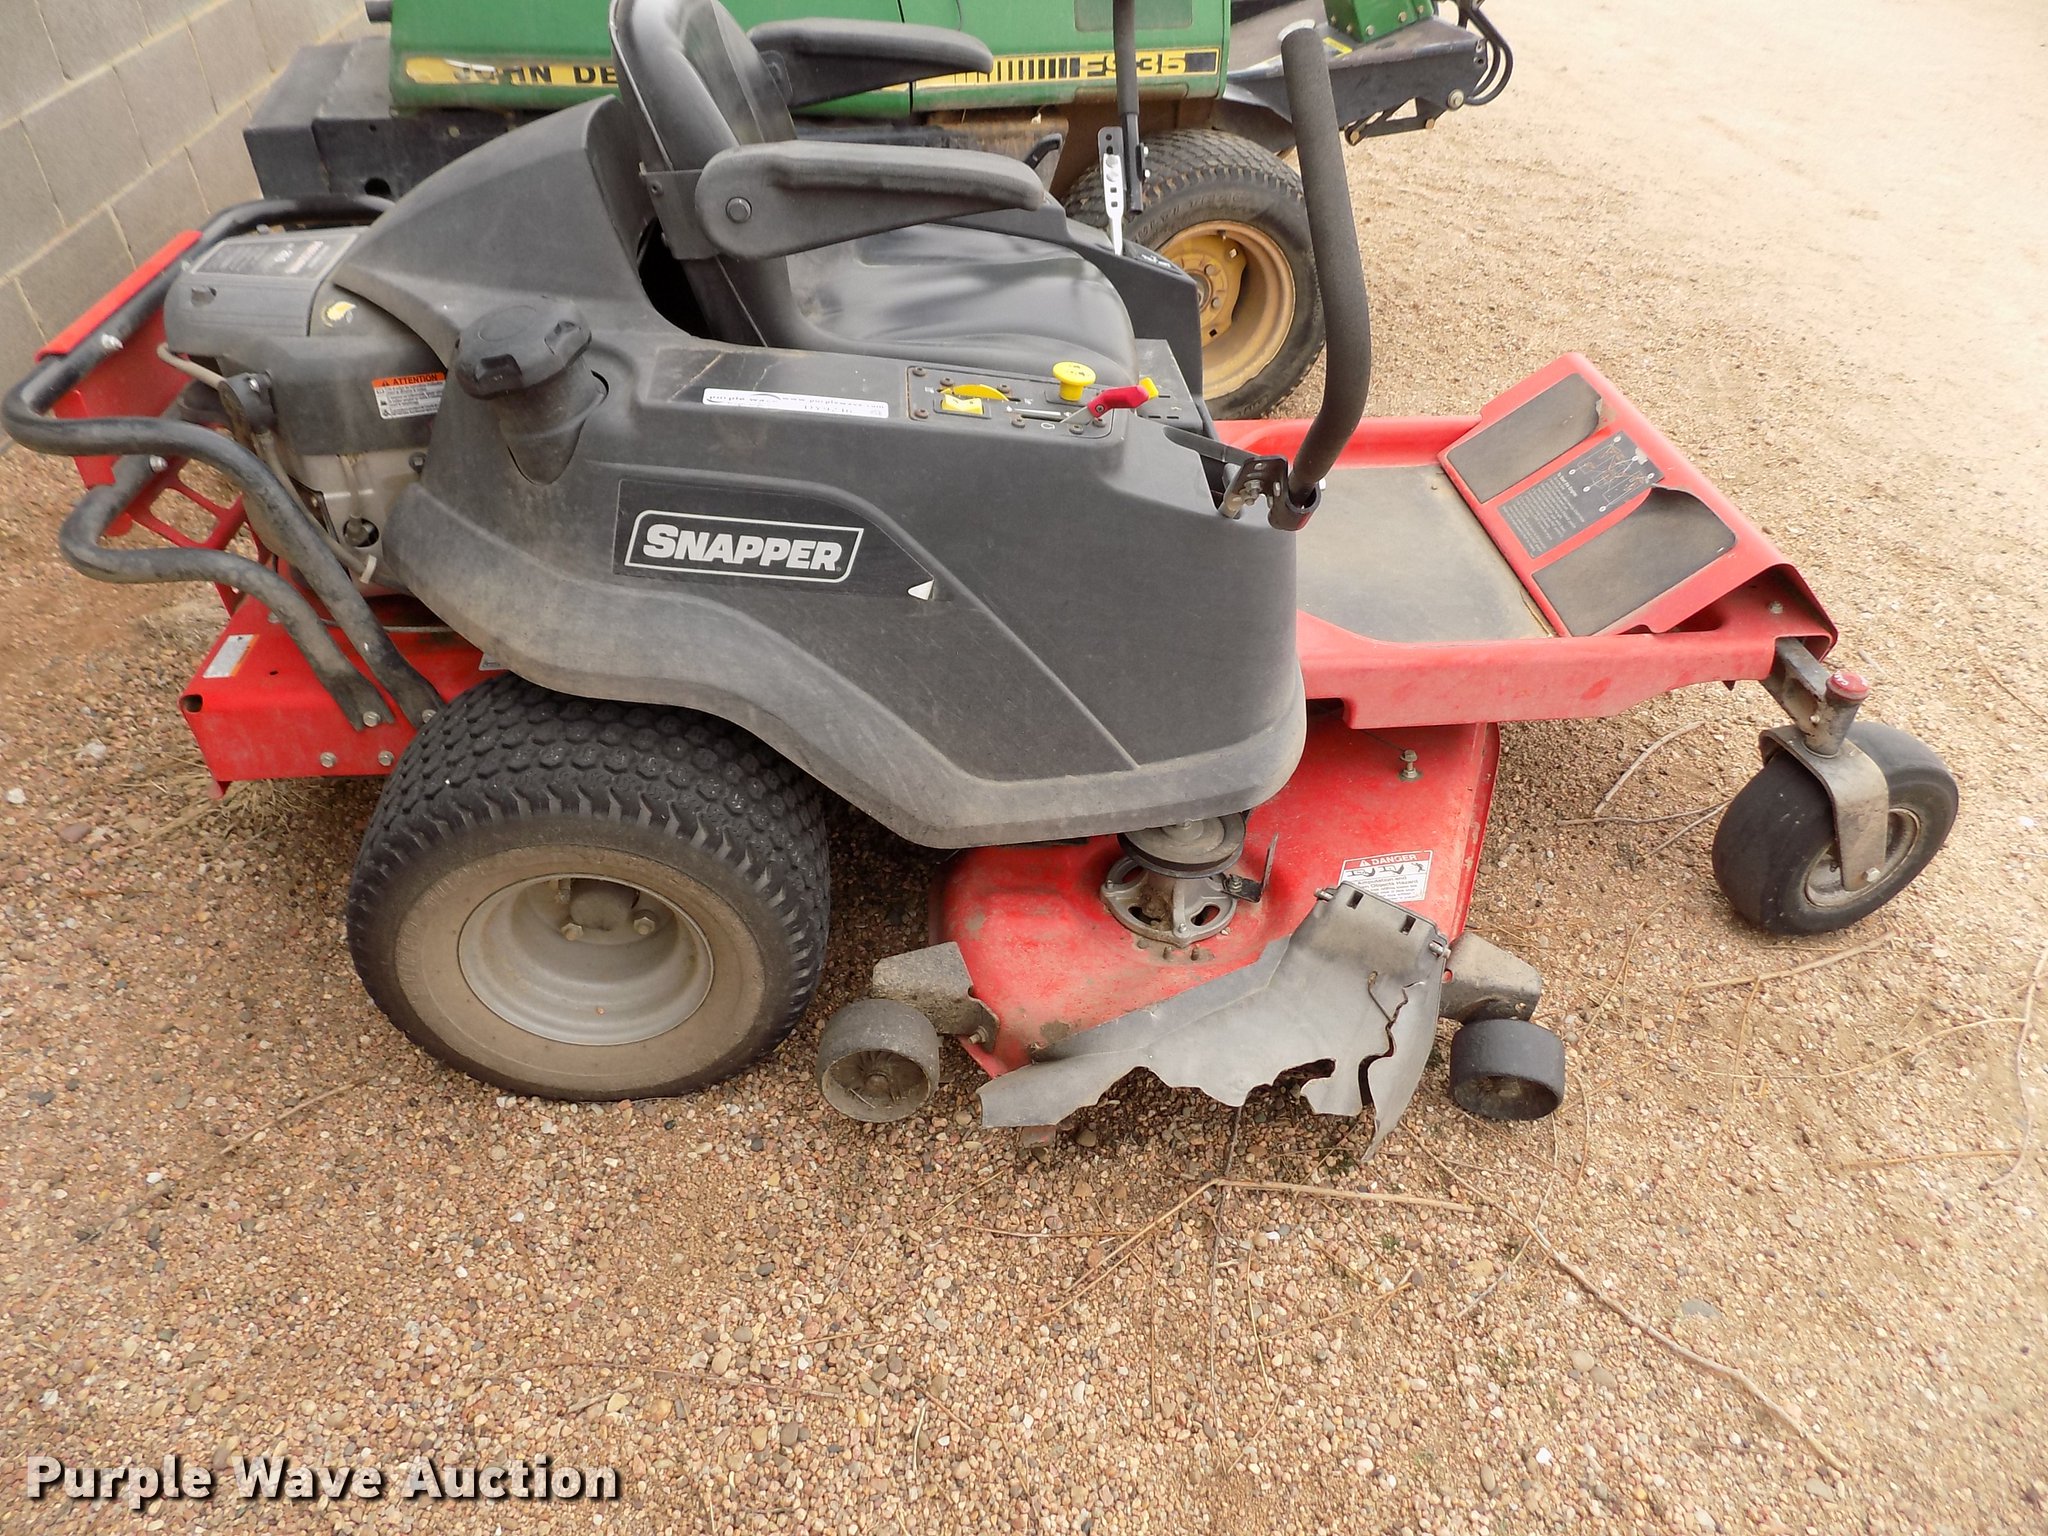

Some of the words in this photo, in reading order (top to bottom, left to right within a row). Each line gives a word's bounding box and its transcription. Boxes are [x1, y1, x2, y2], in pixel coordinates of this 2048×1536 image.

[393, 375, 437, 386] ATTENTION
[643, 523, 843, 572] SNAPPER
[1372, 854, 1417, 864] DANGER
